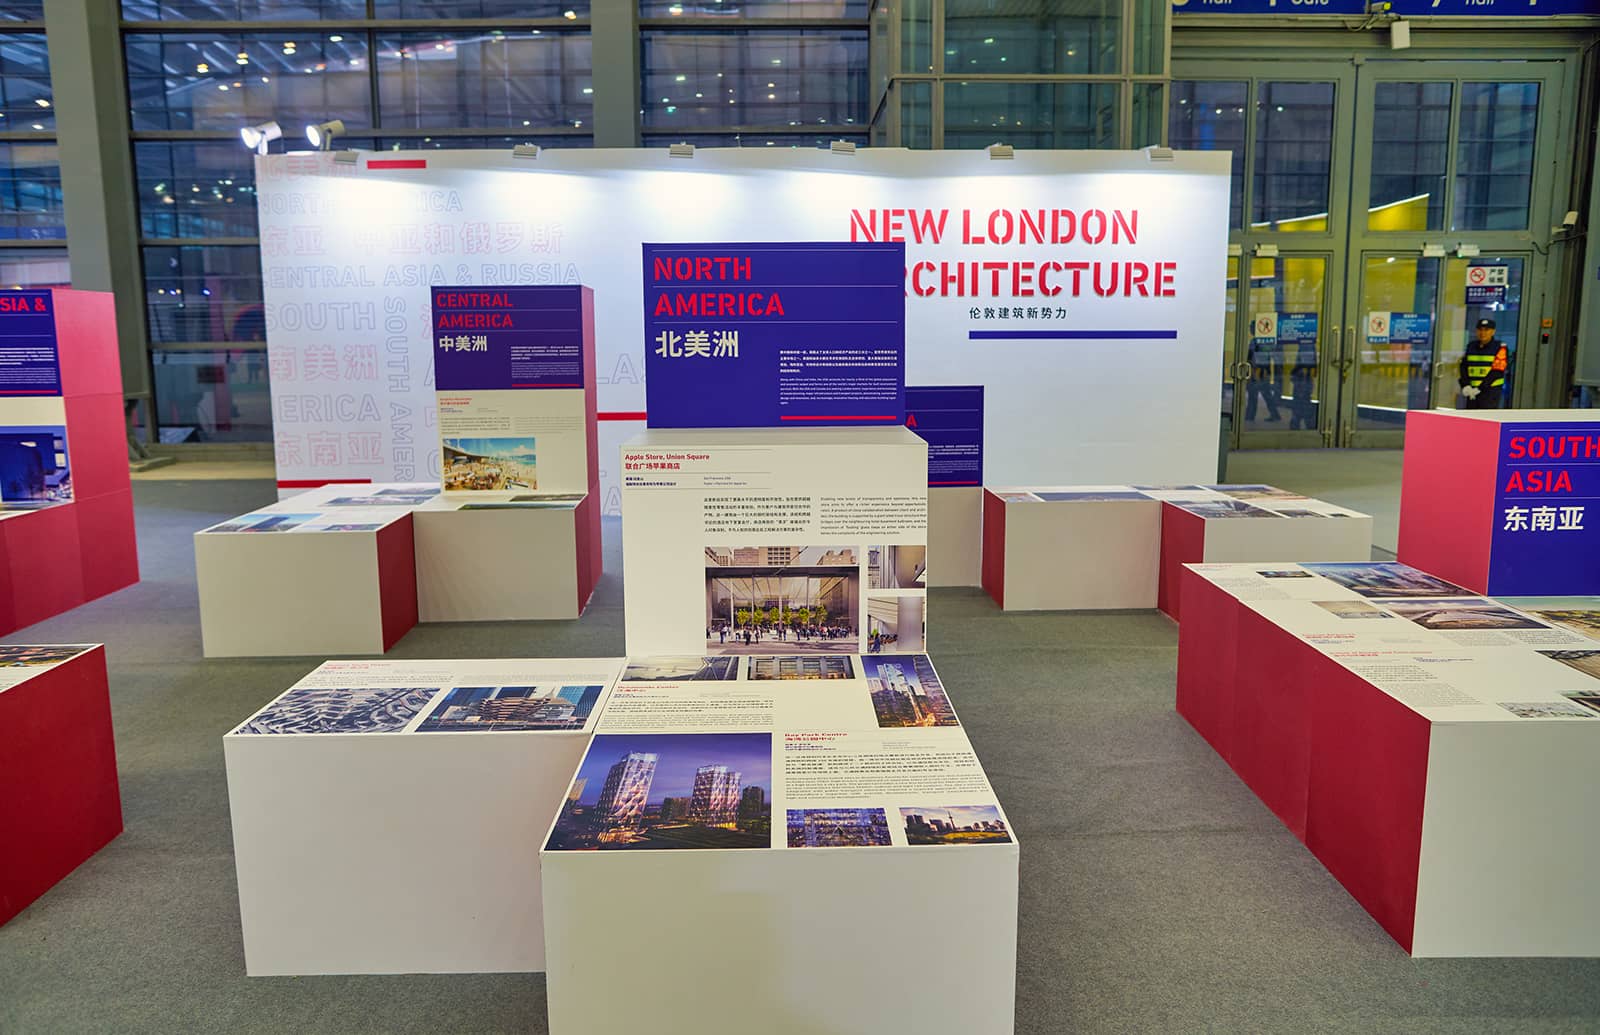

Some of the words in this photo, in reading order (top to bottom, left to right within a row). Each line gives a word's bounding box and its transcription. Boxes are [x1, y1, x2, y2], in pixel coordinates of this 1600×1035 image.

[850, 209, 949, 244] NEW
[962, 209, 1138, 244] LONDON
[384, 263, 446, 287] ASIA
[456, 263, 472, 284] &
[481, 262, 582, 285] RUSSIA
[653, 257, 752, 281] NORTH
[904, 262, 1177, 297] CHITECTURE
[34, 297, 46, 312] &
[437, 294, 513, 308] CENTRAL
[654, 293, 785, 317] AMERICA
[438, 314, 513, 328] AMERICA
[969, 307, 1067, 320] 伦敦建筑新势力
[439, 336, 488, 352] 中美洲
[655, 330, 740, 358] 北美洲
[687, 454, 710, 462] Square
[1508, 436, 1600, 459] SOUTH
[1505, 470, 1573, 493] ASIA
[1504, 506, 1585, 532] 东南亚
